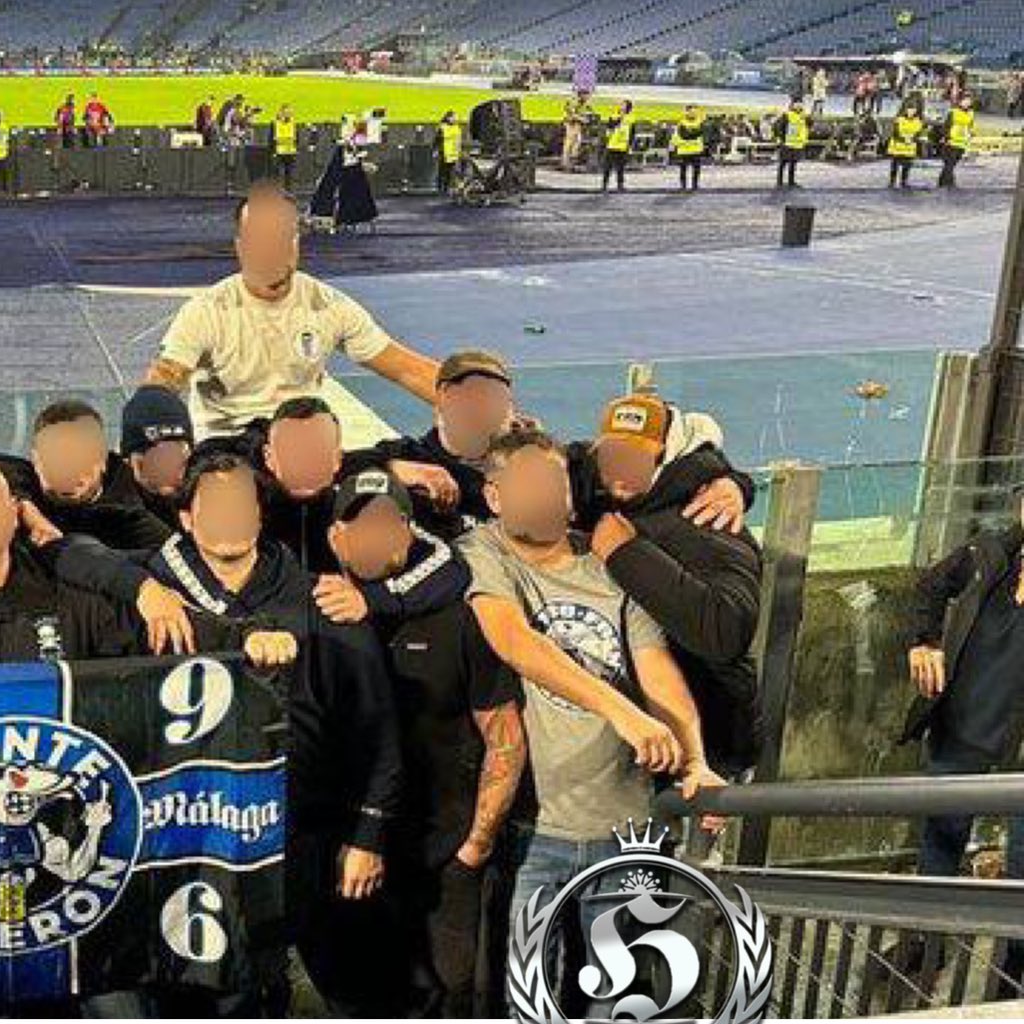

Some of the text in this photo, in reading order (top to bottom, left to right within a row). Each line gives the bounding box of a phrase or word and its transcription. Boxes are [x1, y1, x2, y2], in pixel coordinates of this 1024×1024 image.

[159, 658, 234, 745] 9
[143, 790, 279, 843] Málaga
[160, 882, 229, 963] 6
